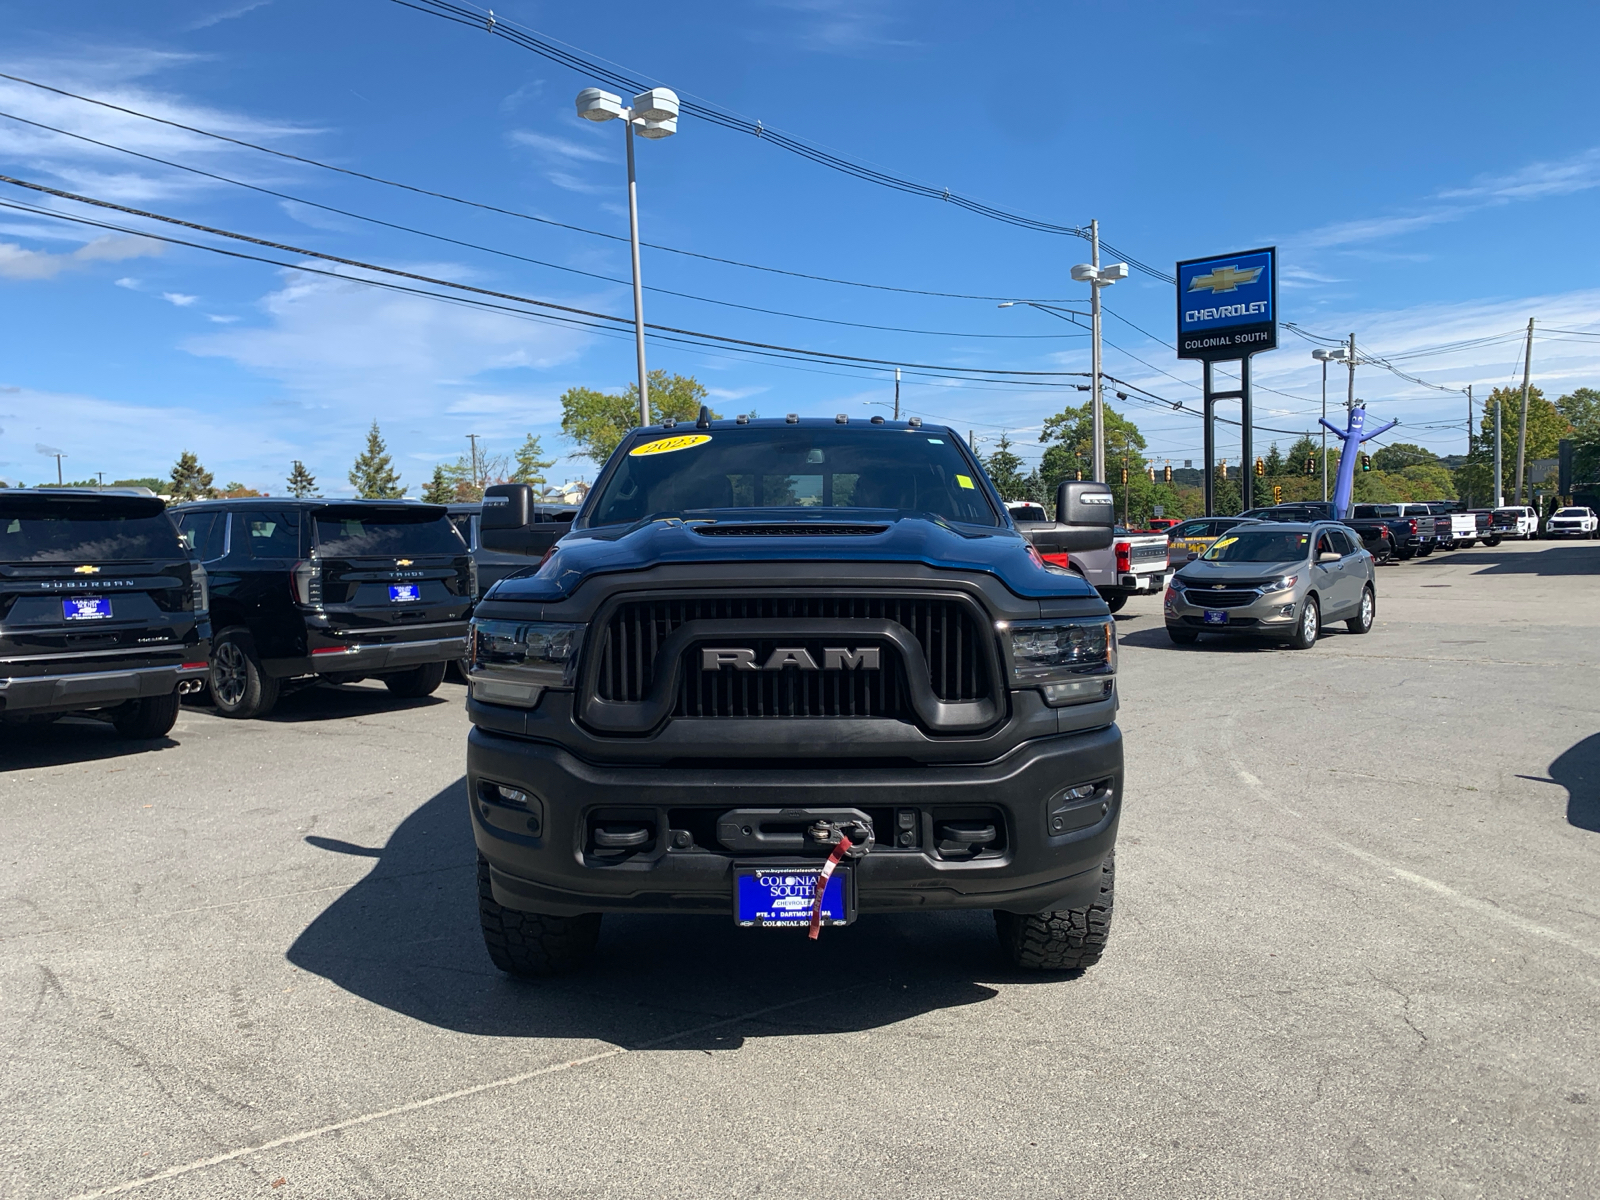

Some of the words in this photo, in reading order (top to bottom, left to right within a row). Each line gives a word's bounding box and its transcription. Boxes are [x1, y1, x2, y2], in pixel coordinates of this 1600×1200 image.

[1185, 301, 1267, 322] CHEVROLET
[1185, 337, 1232, 349] COLONIAL
[1235, 332, 1268, 344] SOUTH
[644, 436, 698, 453] 2023
[41, 580, 134, 588] SUBURBAN
[701, 647, 880, 670] RAM
[770, 886, 816, 897] SOUTH
